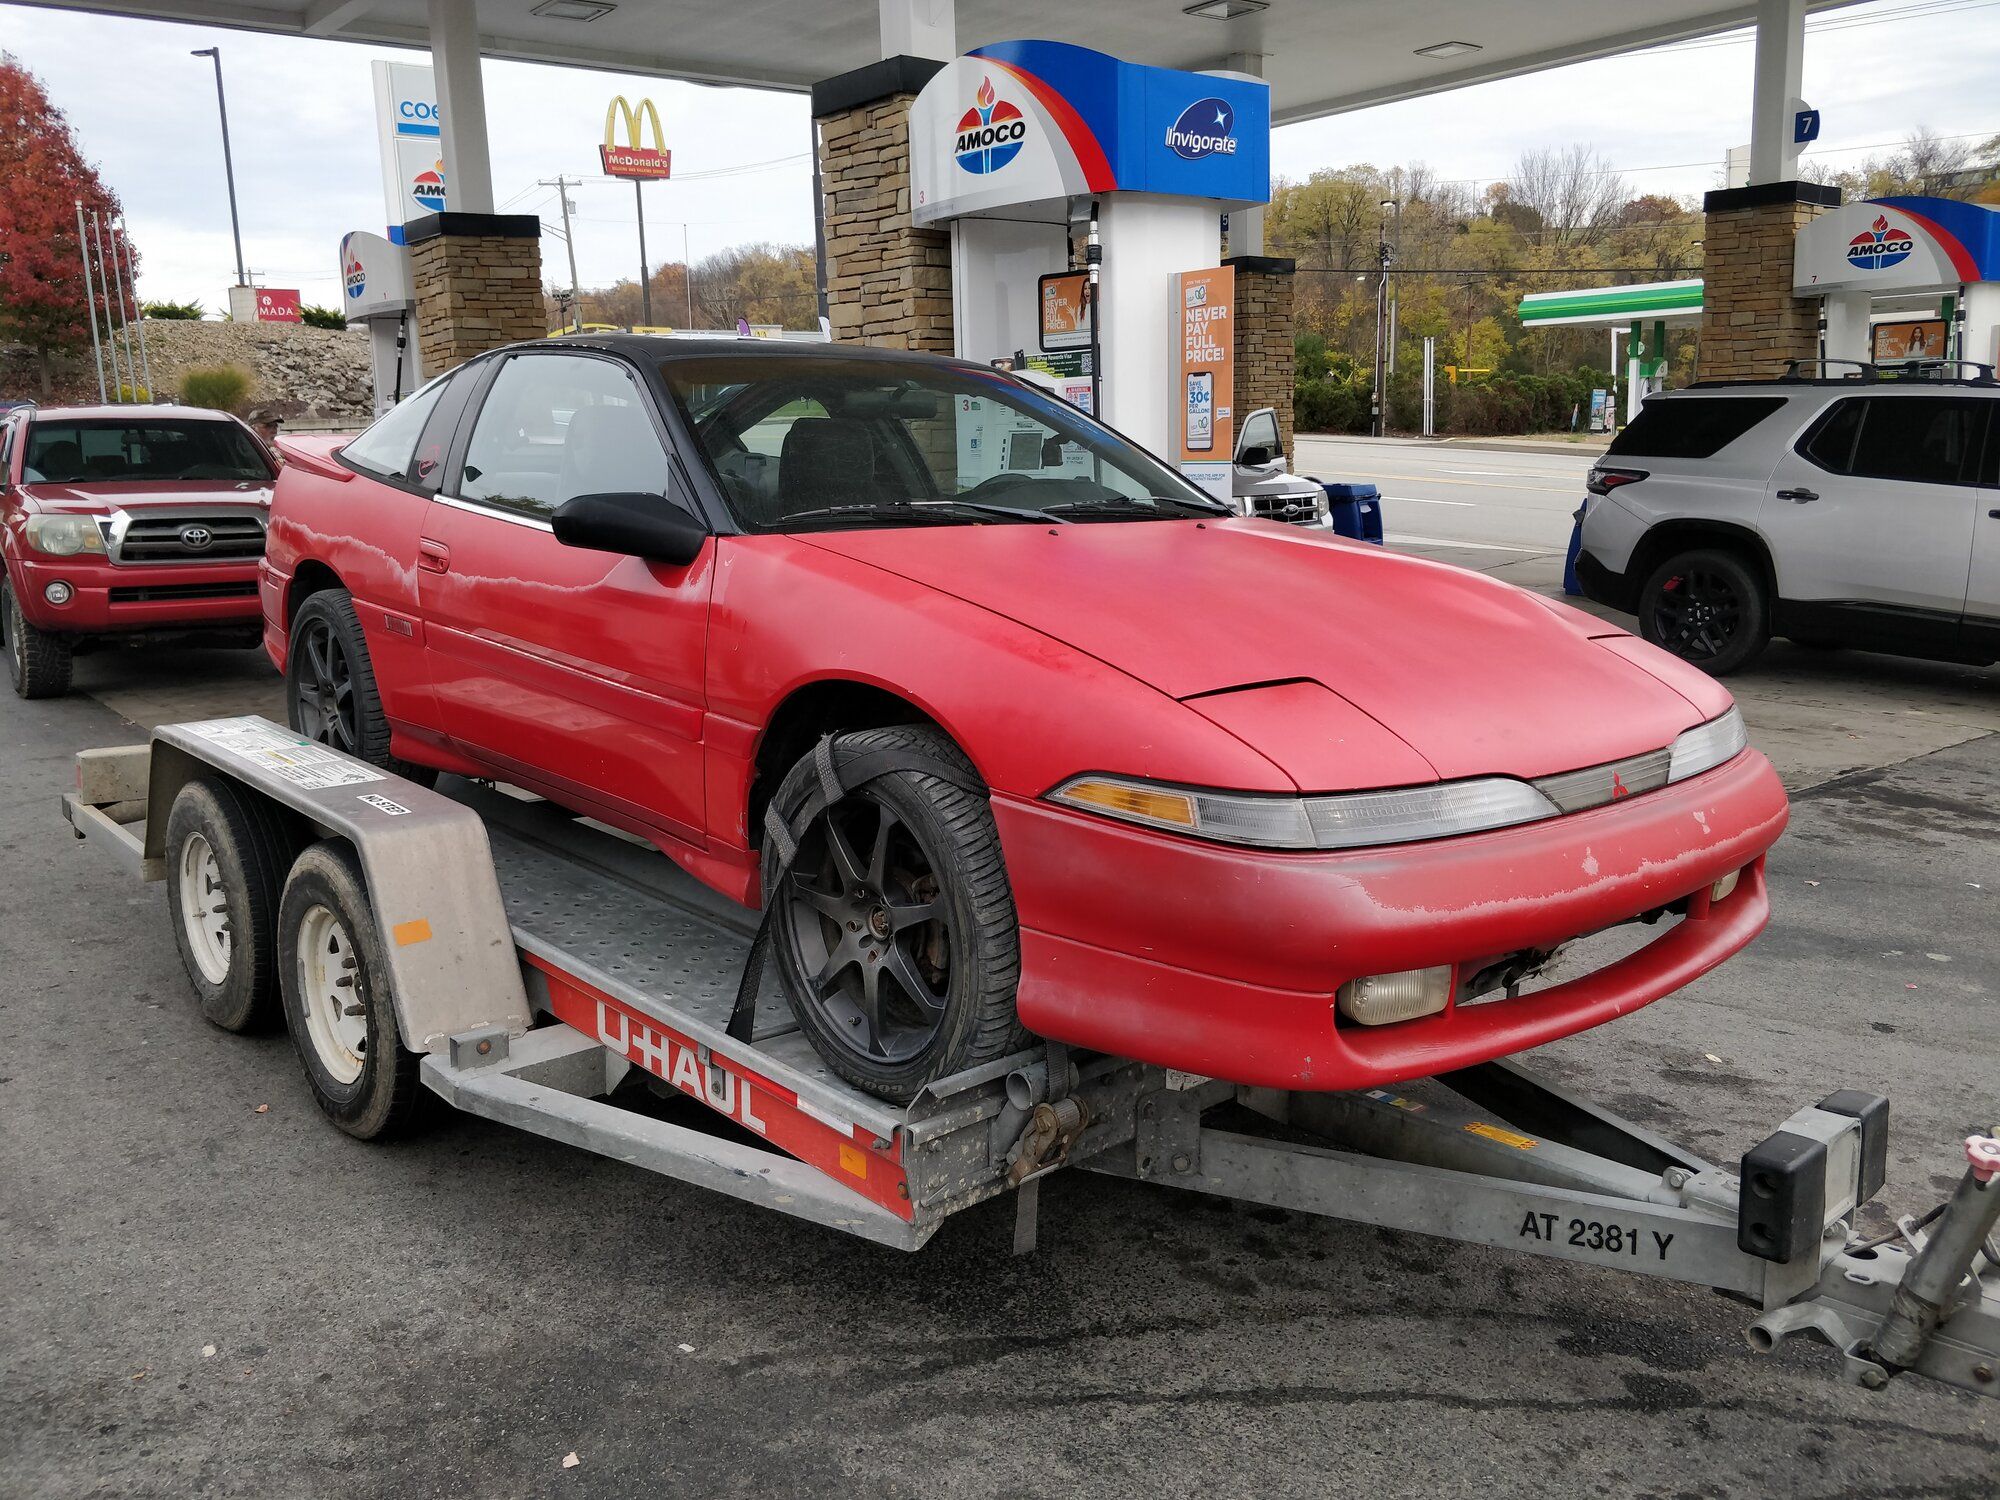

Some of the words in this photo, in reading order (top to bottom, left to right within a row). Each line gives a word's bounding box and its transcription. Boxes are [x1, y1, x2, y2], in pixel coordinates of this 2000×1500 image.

[1802, 116, 1812, 134] 7
[955, 121, 1026, 154] AMOCO
[1166, 128, 1237, 153] Invigorate
[608, 155, 668, 168] McDonald's
[919, 190, 925, 204] 3
[1847, 241, 1914, 257] AMOCO
[1812, 275, 1817, 284] 7
[1046, 298, 1067, 307] NEVER
[259, 307, 294, 316] MADA
[1186, 306, 1227, 323] NEVER
[1186, 321, 1208, 336] PAY
[1186, 335, 1215, 349] FULL
[1186, 348, 1225, 363] PRICE!
[1189, 391, 1210, 403] 30¢
[963, 400, 969, 411] 3
[597, 1000, 766, 1134] U-HAUL
[1519, 1211, 1559, 1241] AT
[1568, 1218, 1638, 1256] 2381
[1652, 1230, 1674, 1260] Y
